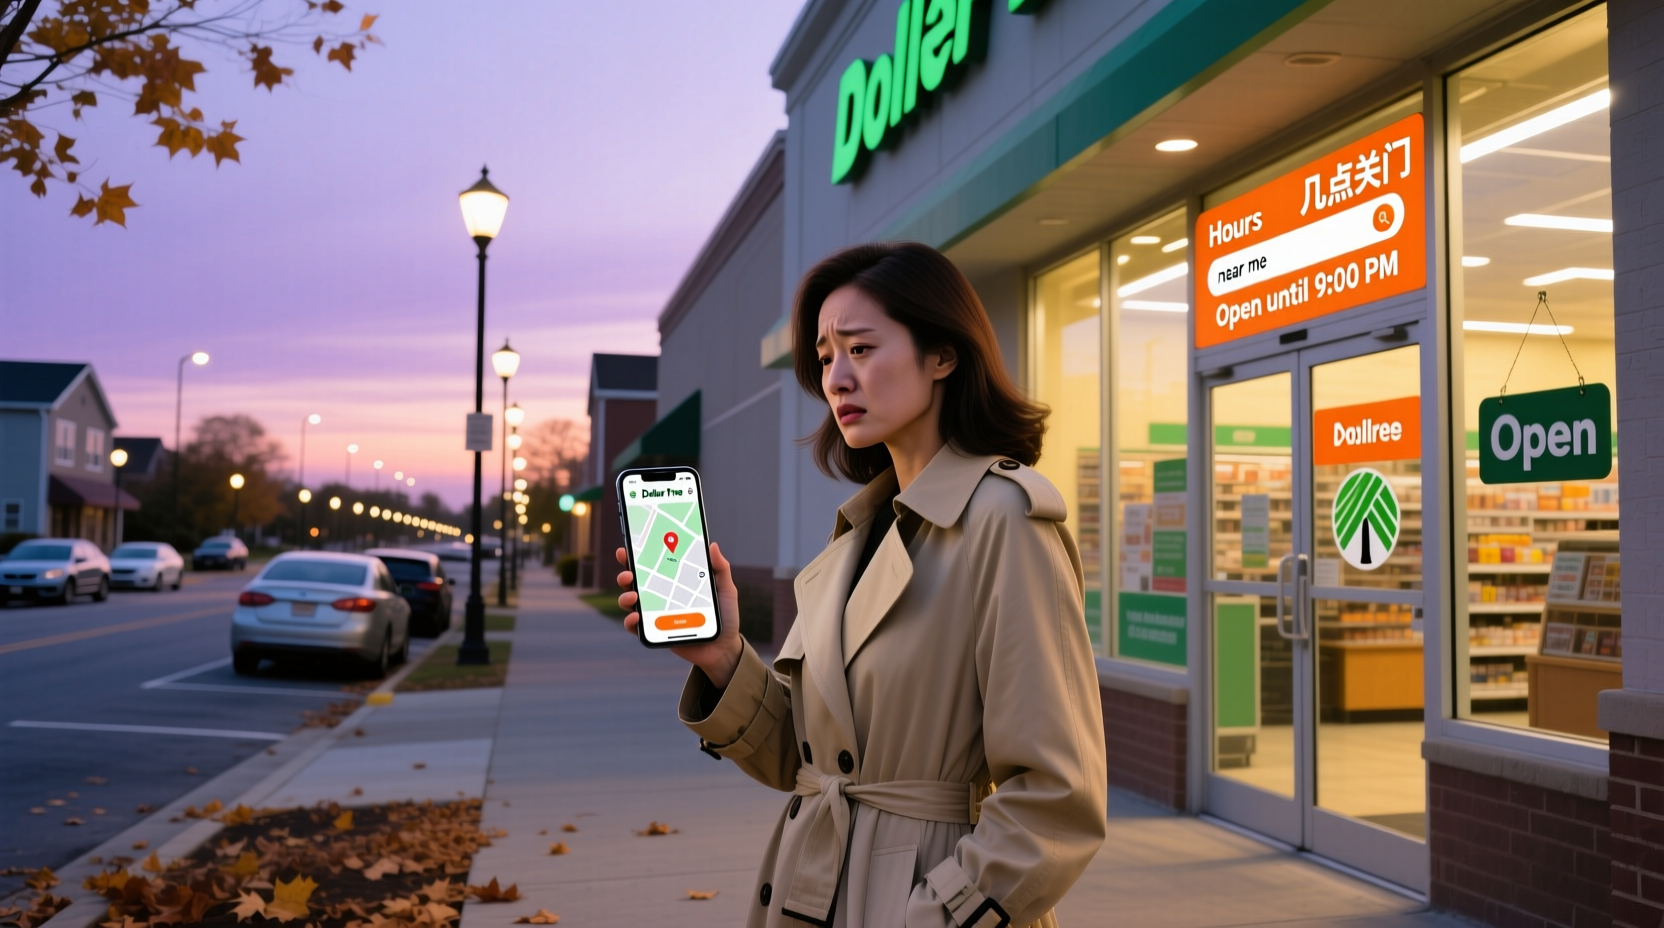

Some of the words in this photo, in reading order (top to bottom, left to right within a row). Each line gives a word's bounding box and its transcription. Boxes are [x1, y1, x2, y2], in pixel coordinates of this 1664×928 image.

[1300, 136, 1411, 216] 几点关门
[1208, 211, 1263, 248] Hours
[1215, 297, 1263, 331] Open
[1266, 276, 1309, 312] until
[1314, 262, 1359, 298] 9:00
[1364, 250, 1399, 284] PM
[1217, 263, 1245, 284] near
[1248, 256, 1267, 273] me
[1490, 413, 1597, 472] Open
